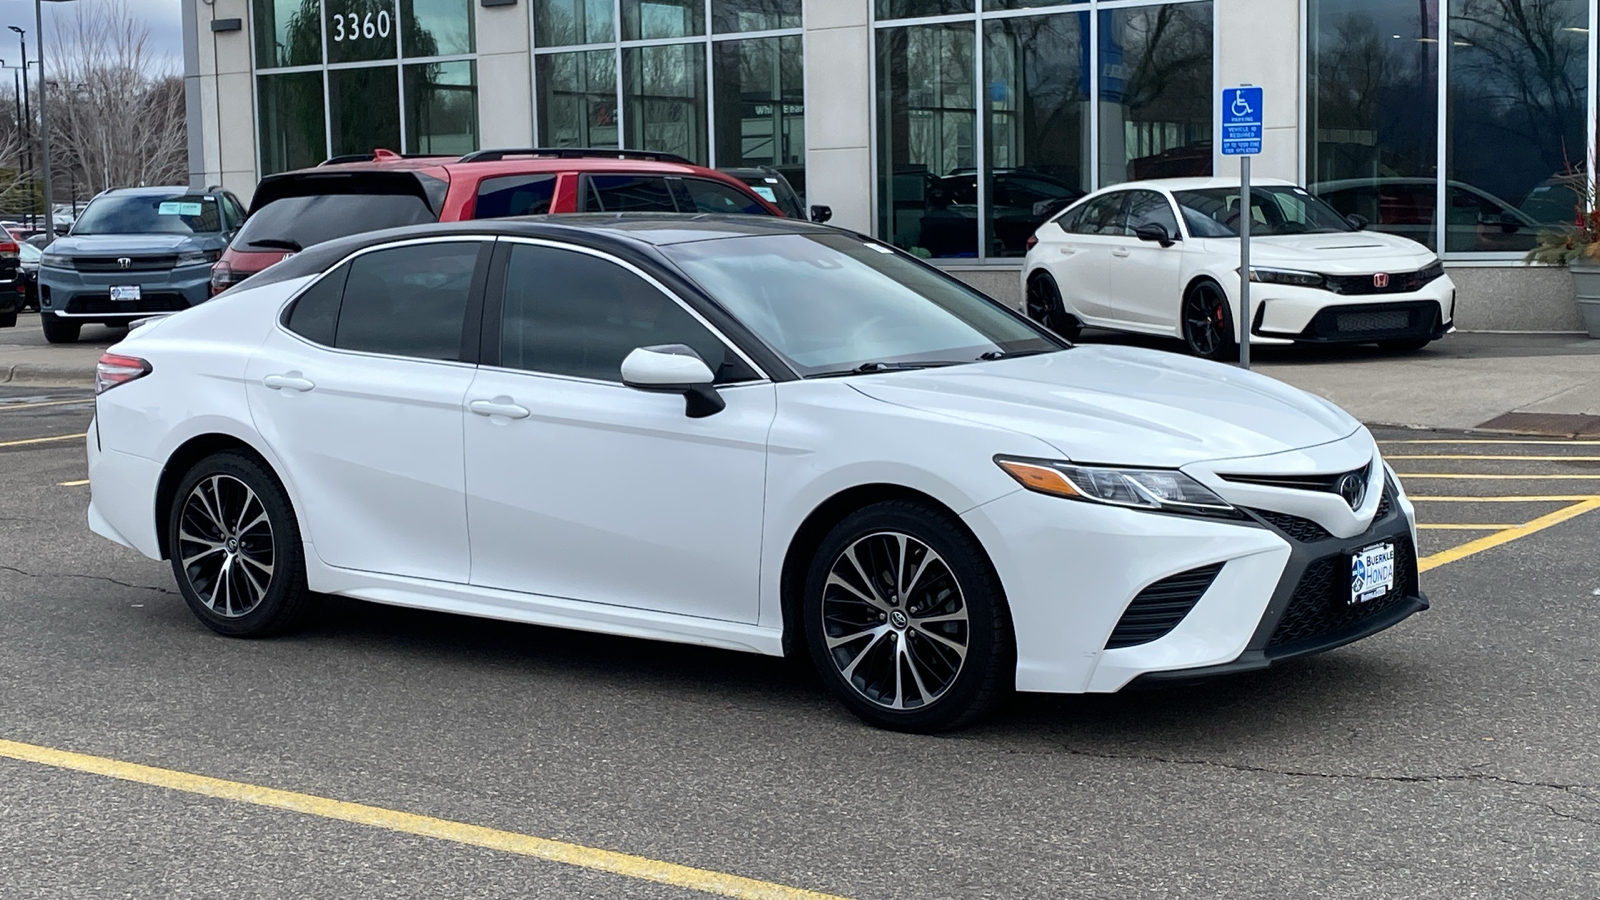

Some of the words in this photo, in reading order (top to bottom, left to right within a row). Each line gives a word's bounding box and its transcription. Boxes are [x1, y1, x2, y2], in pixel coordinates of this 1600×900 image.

[333, 10, 390, 42] 3360
[1366, 550, 1394, 567] BUERKLE
[1366, 564, 1393, 586] HONDA
